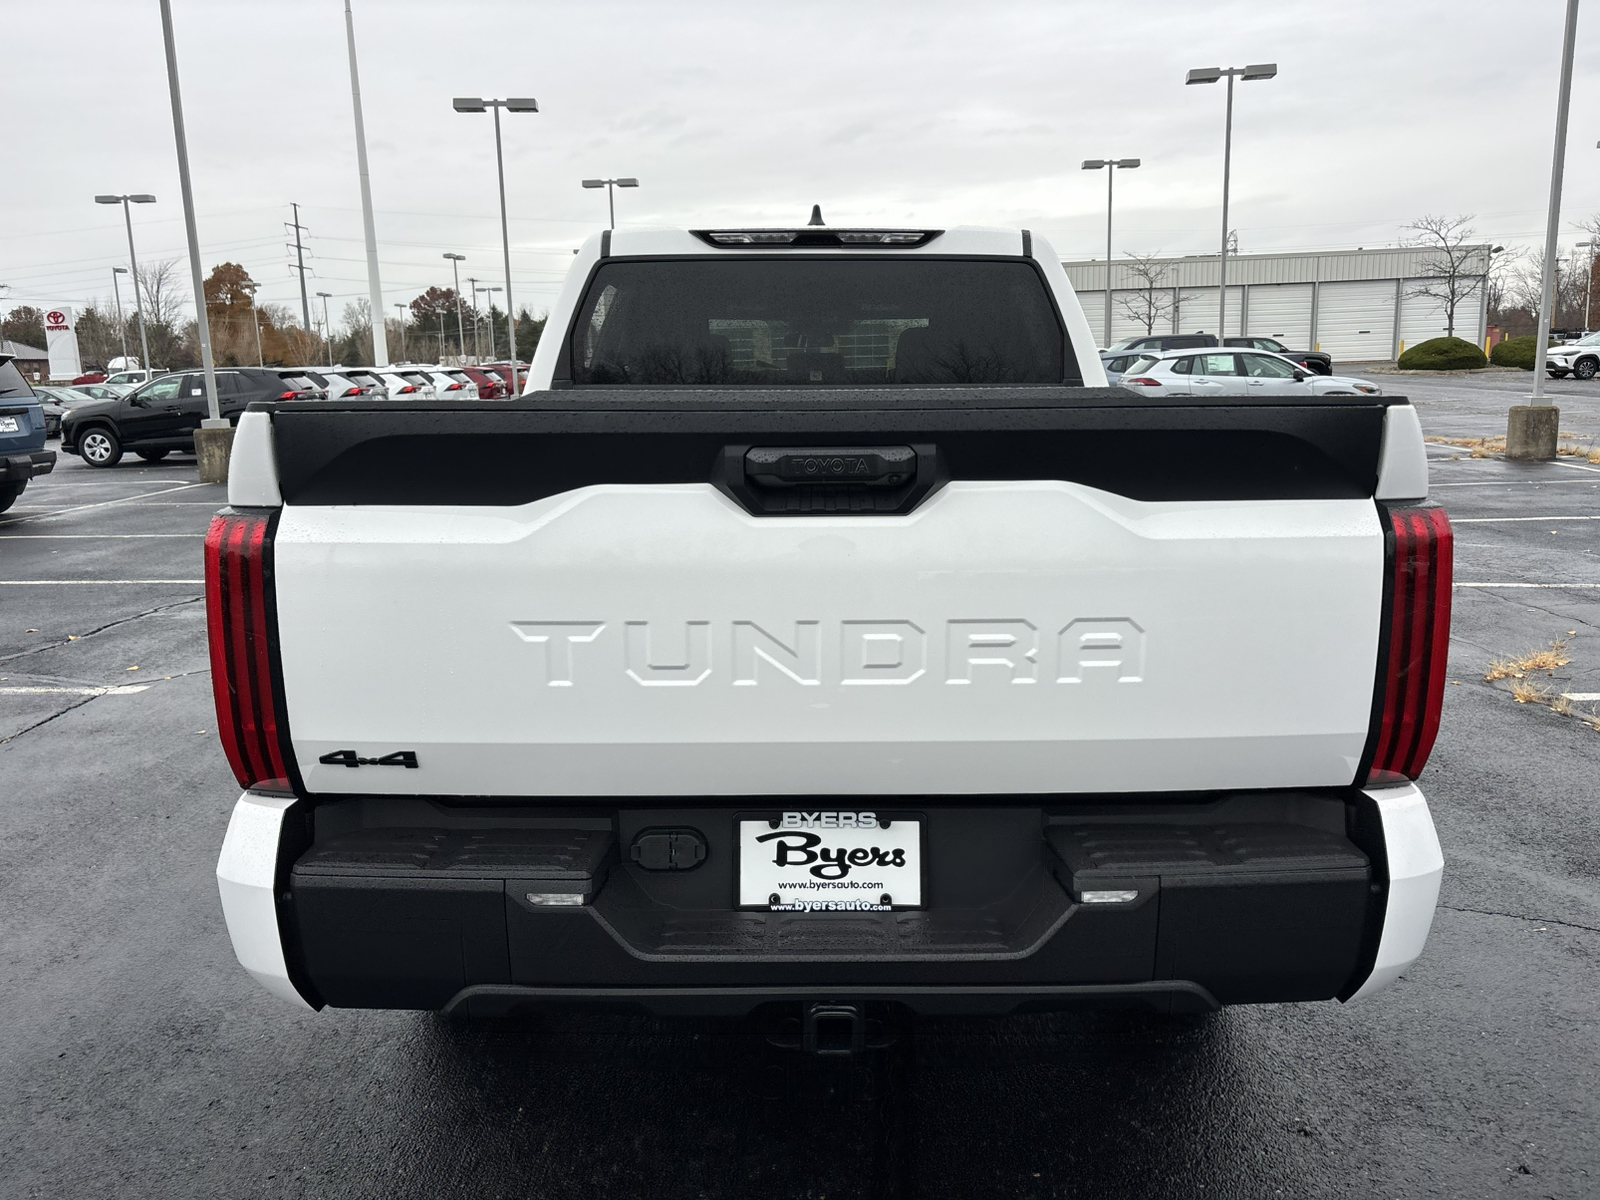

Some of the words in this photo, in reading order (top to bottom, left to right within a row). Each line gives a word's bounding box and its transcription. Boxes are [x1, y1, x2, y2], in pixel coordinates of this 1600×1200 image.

[791, 458, 870, 474] TOYOTA
[509, 617, 1147, 686] TUNDRA
[781, 812, 878, 828] BYERS
[755, 831, 906, 880] Byers
[778, 880, 883, 891] www.byersauto.com
[770, 898, 892, 912] www.byersauto.com
